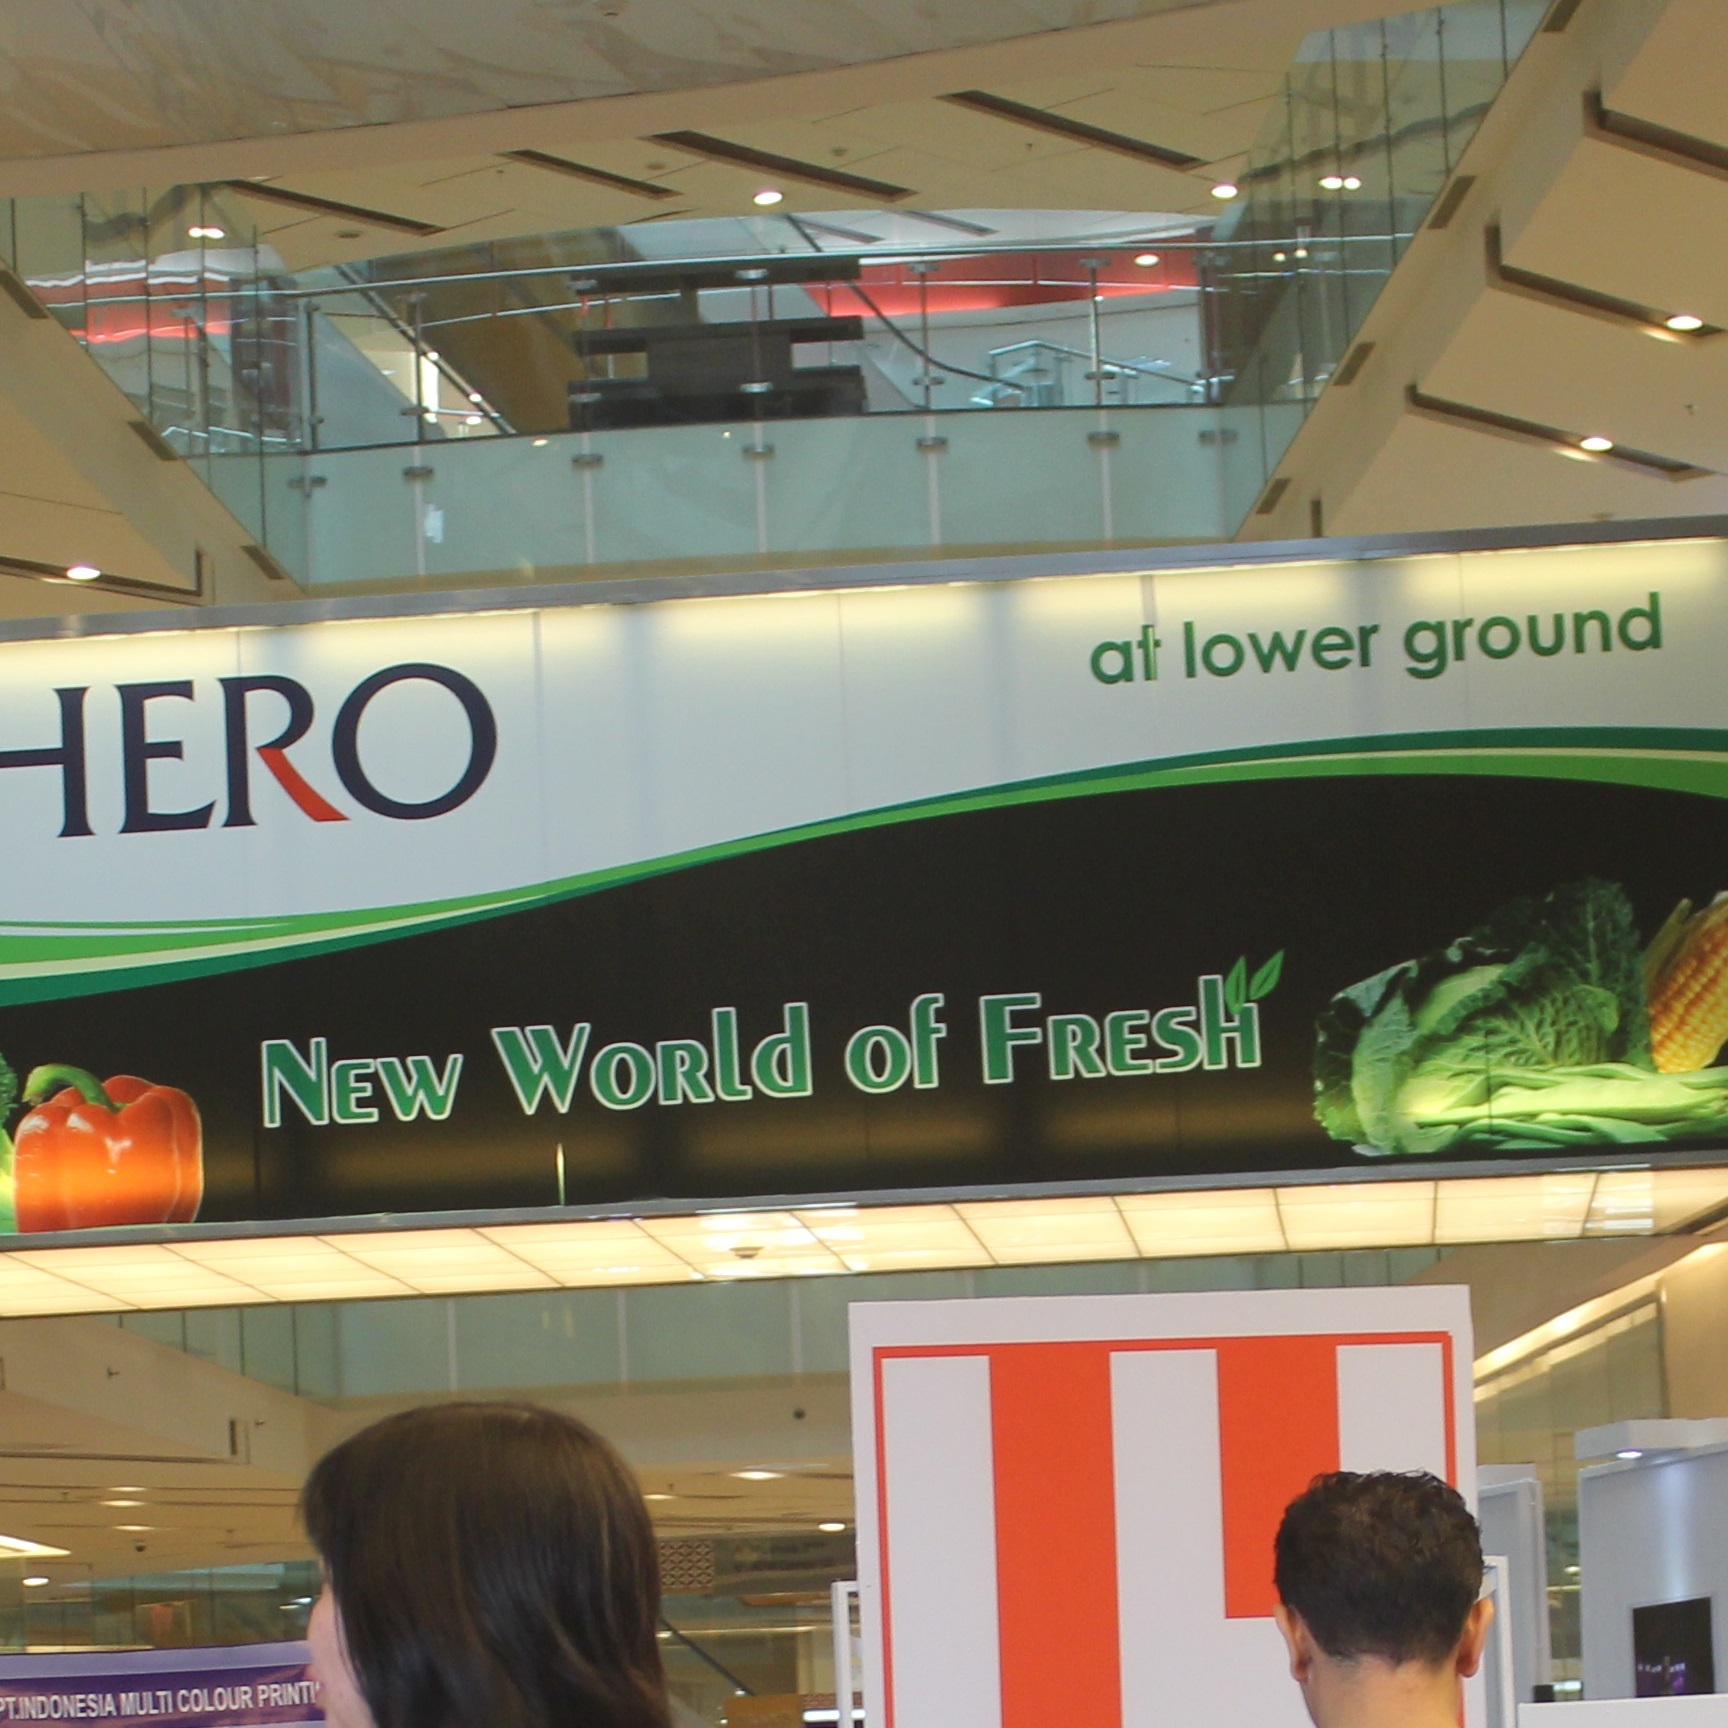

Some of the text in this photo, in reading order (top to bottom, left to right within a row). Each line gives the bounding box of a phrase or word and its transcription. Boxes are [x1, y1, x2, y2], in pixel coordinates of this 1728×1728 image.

[1090, 592, 1662, 684] at lower ground
[845, 992, 947, 1094] of
[121, 1690, 173, 1716] MULTI
[177, 1685, 253, 1713] COLOUR
[257, 1681, 320, 1708] PRINTI
